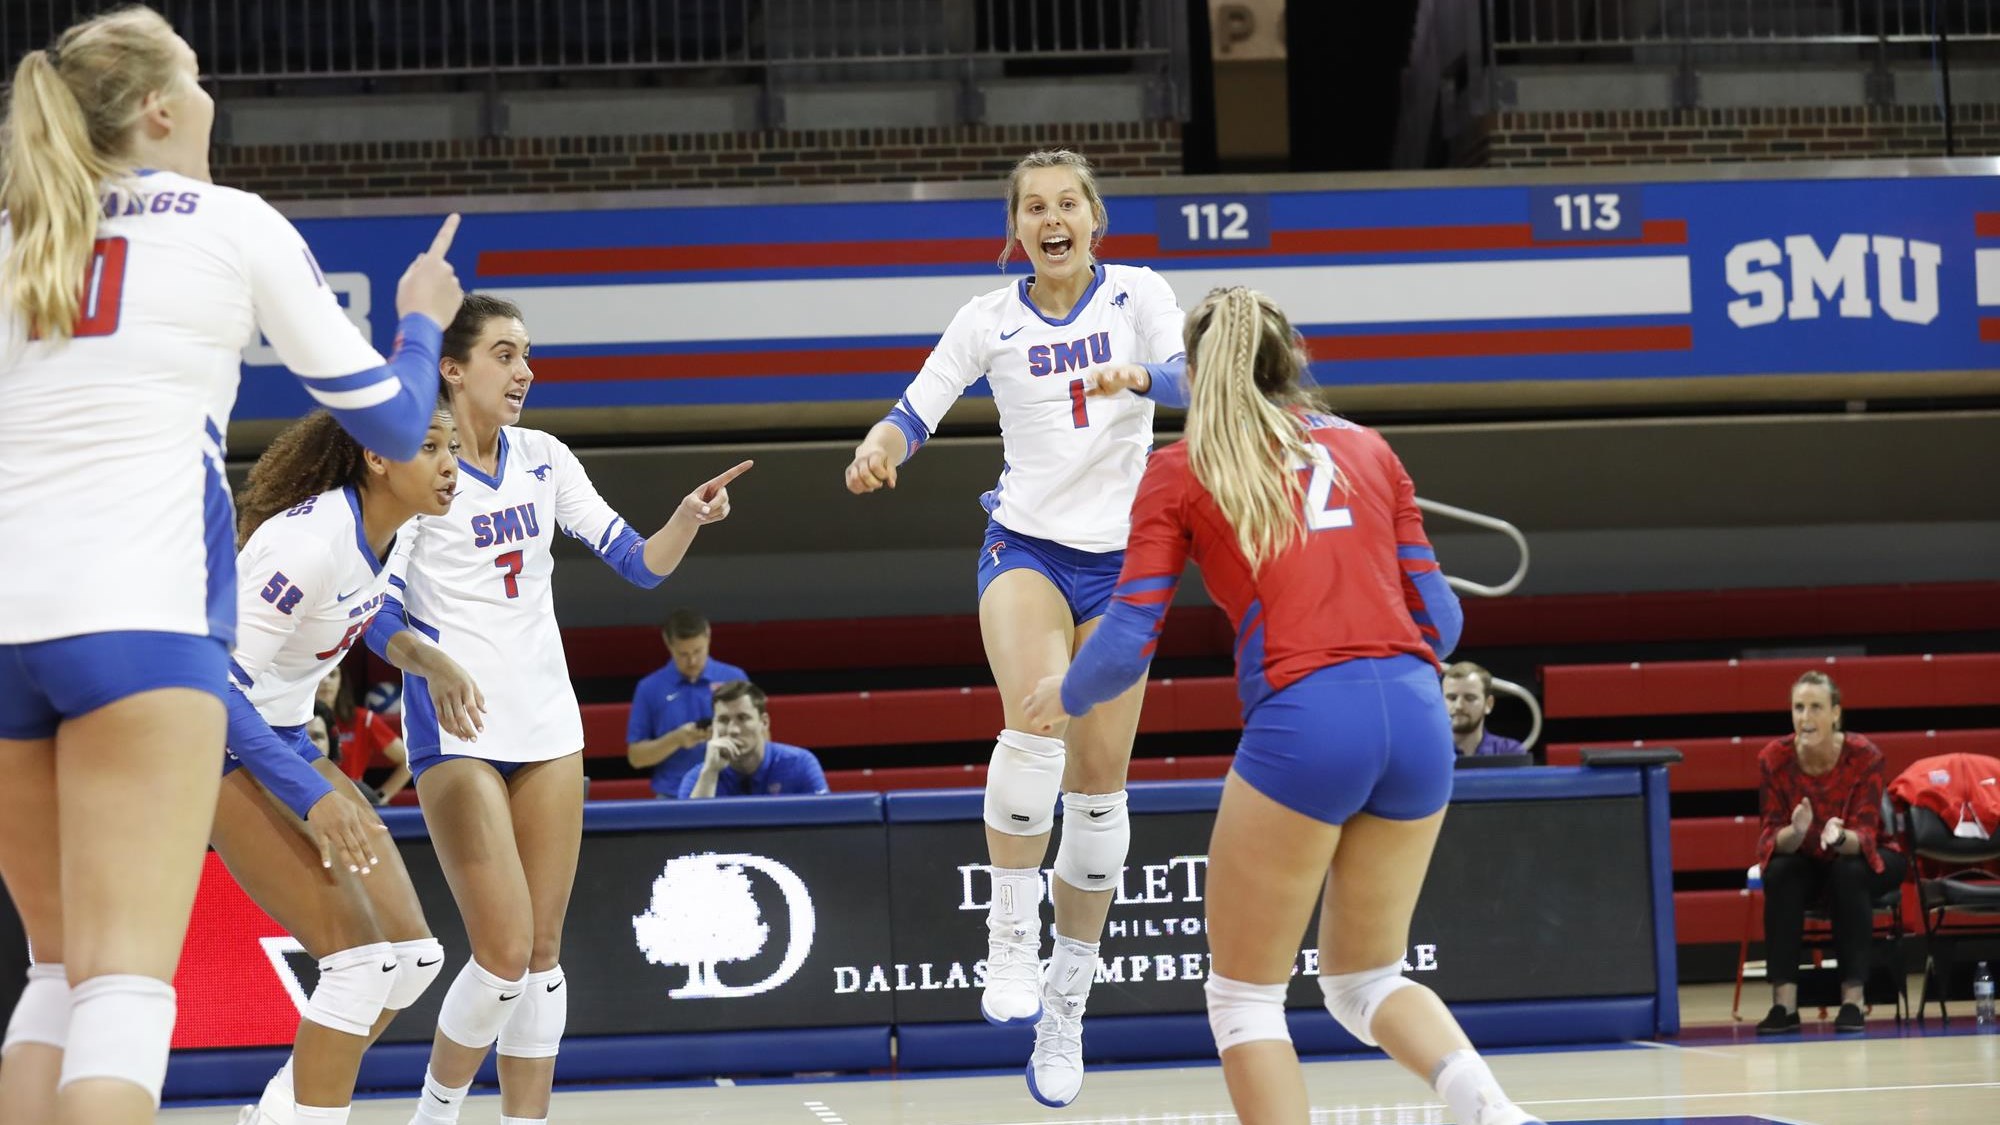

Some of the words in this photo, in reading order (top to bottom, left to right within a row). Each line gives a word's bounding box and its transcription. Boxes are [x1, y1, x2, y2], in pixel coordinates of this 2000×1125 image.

[1181, 203, 1249, 241] 112
[1554, 194, 1622, 231] 113
[1725, 233, 1942, 329] SMU
[1028, 331, 1112, 377] SMU
[1069, 378, 1090, 429] 1
[471, 502, 541, 549] SMU
[260, 571, 305, 616] 58
[495, 549, 524, 599] 7
[1109, 917, 1208, 938] HILTO
